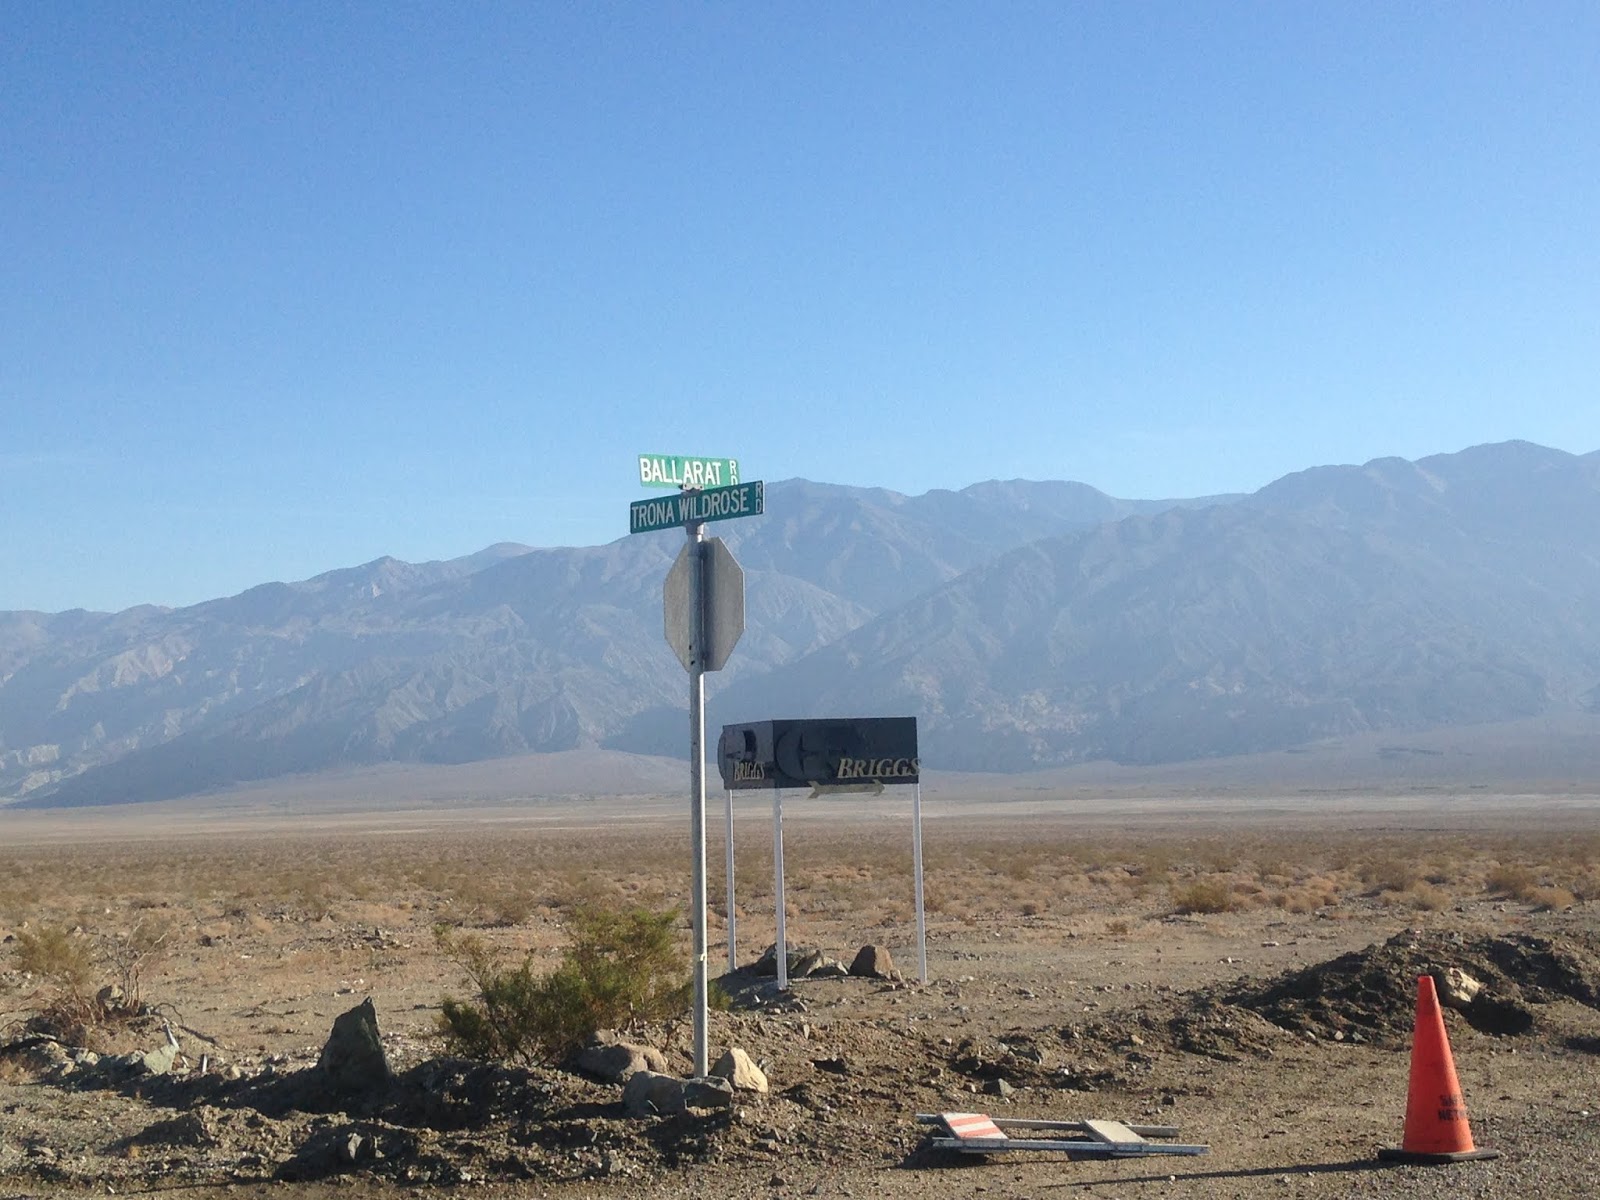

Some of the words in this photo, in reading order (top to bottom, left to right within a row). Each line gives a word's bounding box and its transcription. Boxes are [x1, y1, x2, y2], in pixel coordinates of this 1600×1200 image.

[640, 458, 721, 485] BALLARAT
[631, 501, 675, 529] TRONA
[678, 487, 749, 521] WILDROSE
[837, 757, 921, 779] BRIGGS
